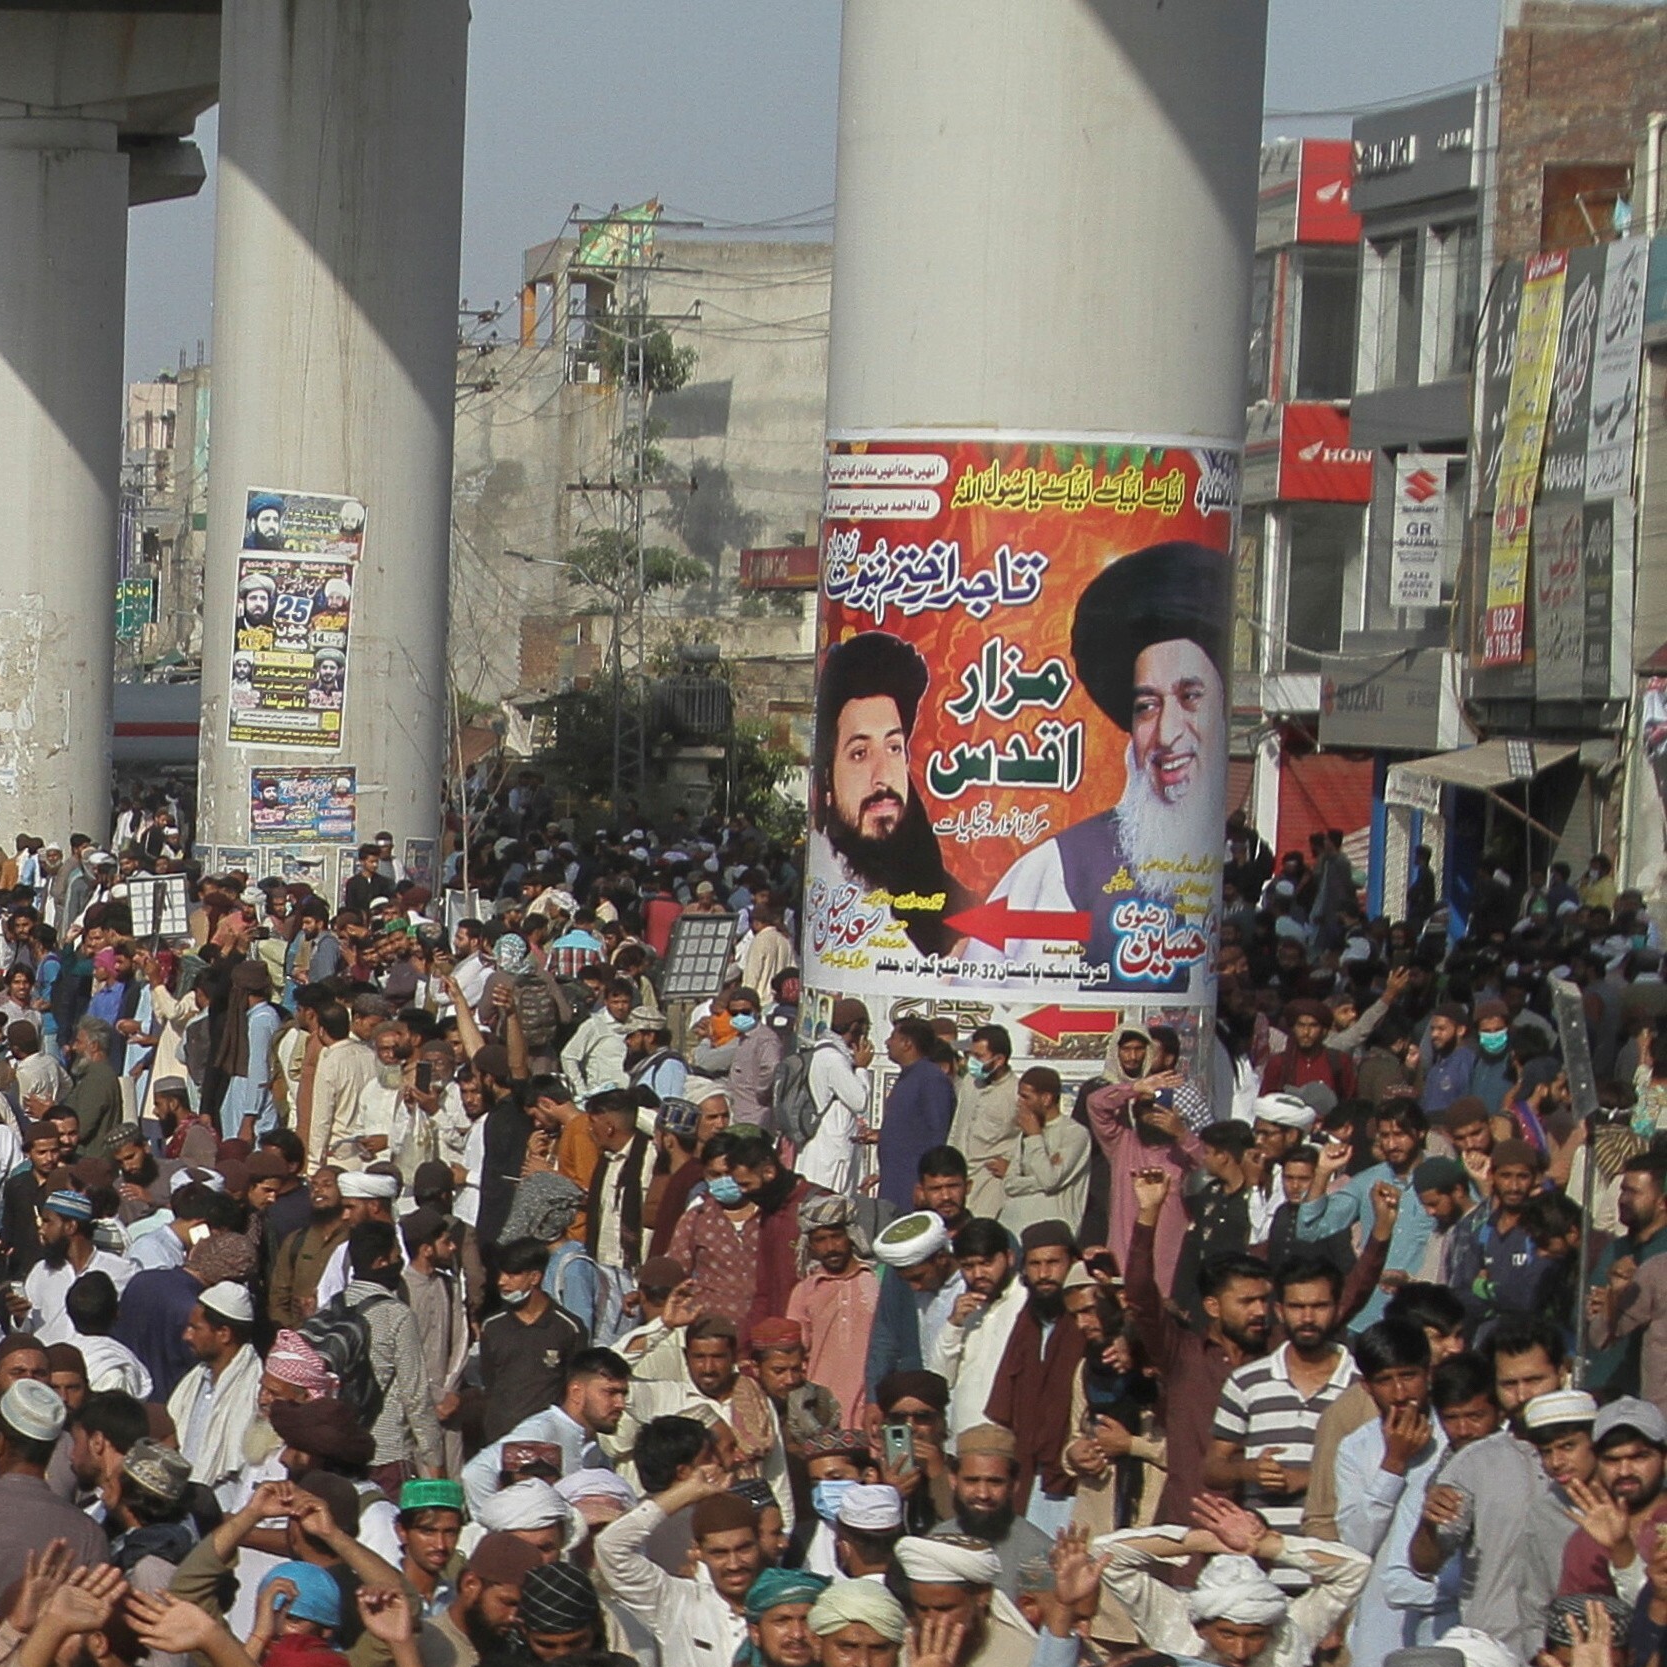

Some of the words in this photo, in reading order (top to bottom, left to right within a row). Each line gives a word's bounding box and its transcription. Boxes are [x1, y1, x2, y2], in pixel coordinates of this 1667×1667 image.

[1406, 521, 1432, 536] GR
[275, 595, 310, 622] 25
[312, 632, 325, 643] 14
[944, 635, 1072, 724] مزار
[927, 719, 1083, 801] اقدس
[1114, 900, 1168, 930] رضوی
[1116, 926, 1207, 979] حسین
[937, 957, 962, 980] ضلع
[998, 958, 1041, 985] پاکستان
[1040, 962, 1074, 981] لبیک
[1073, 961, 1110, 986] تحریک
